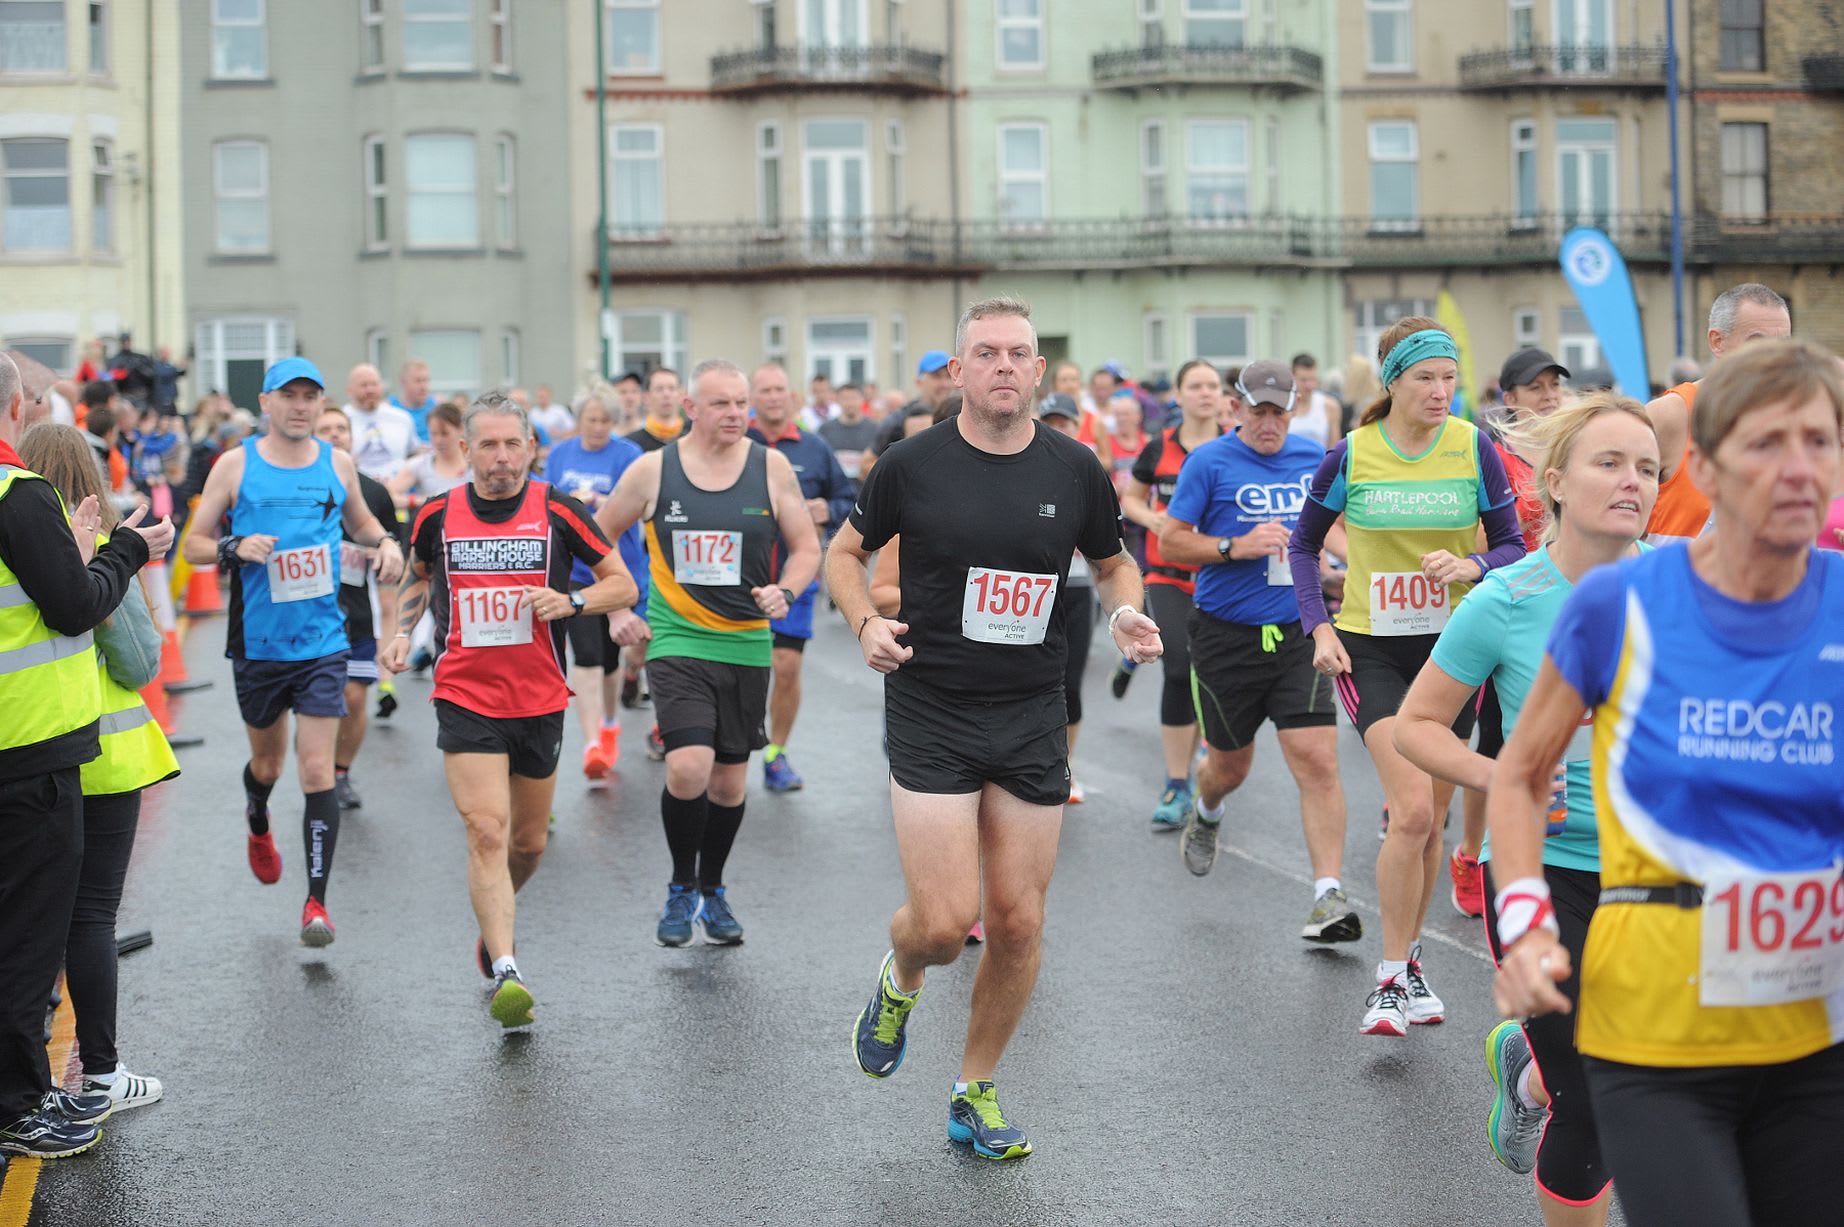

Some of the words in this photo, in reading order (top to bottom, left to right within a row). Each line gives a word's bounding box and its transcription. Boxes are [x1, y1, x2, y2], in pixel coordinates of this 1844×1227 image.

[1364, 490, 1460, 505] HARTLEPOOL
[451, 540, 543, 553] BILLINGHAM
[451, 552, 495, 563] MARSH
[498, 551, 543, 562] HOUSE
[680, 534, 734, 563] 1172
[273, 547, 327, 581] 1631
[458, 562, 507, 570] HARRIERS
[515, 561, 534, 569] A.C.
[464, 589, 524, 625] 1167
[974, 572, 1053, 617] 1567
[1372, 574, 1446, 611] 1409
[988, 621, 1027, 633] everyone
[1679, 697, 1834, 741] REDCAR
[1678, 735, 1777, 763] RUNNING
[1781, 740, 1835, 765] CLUB
